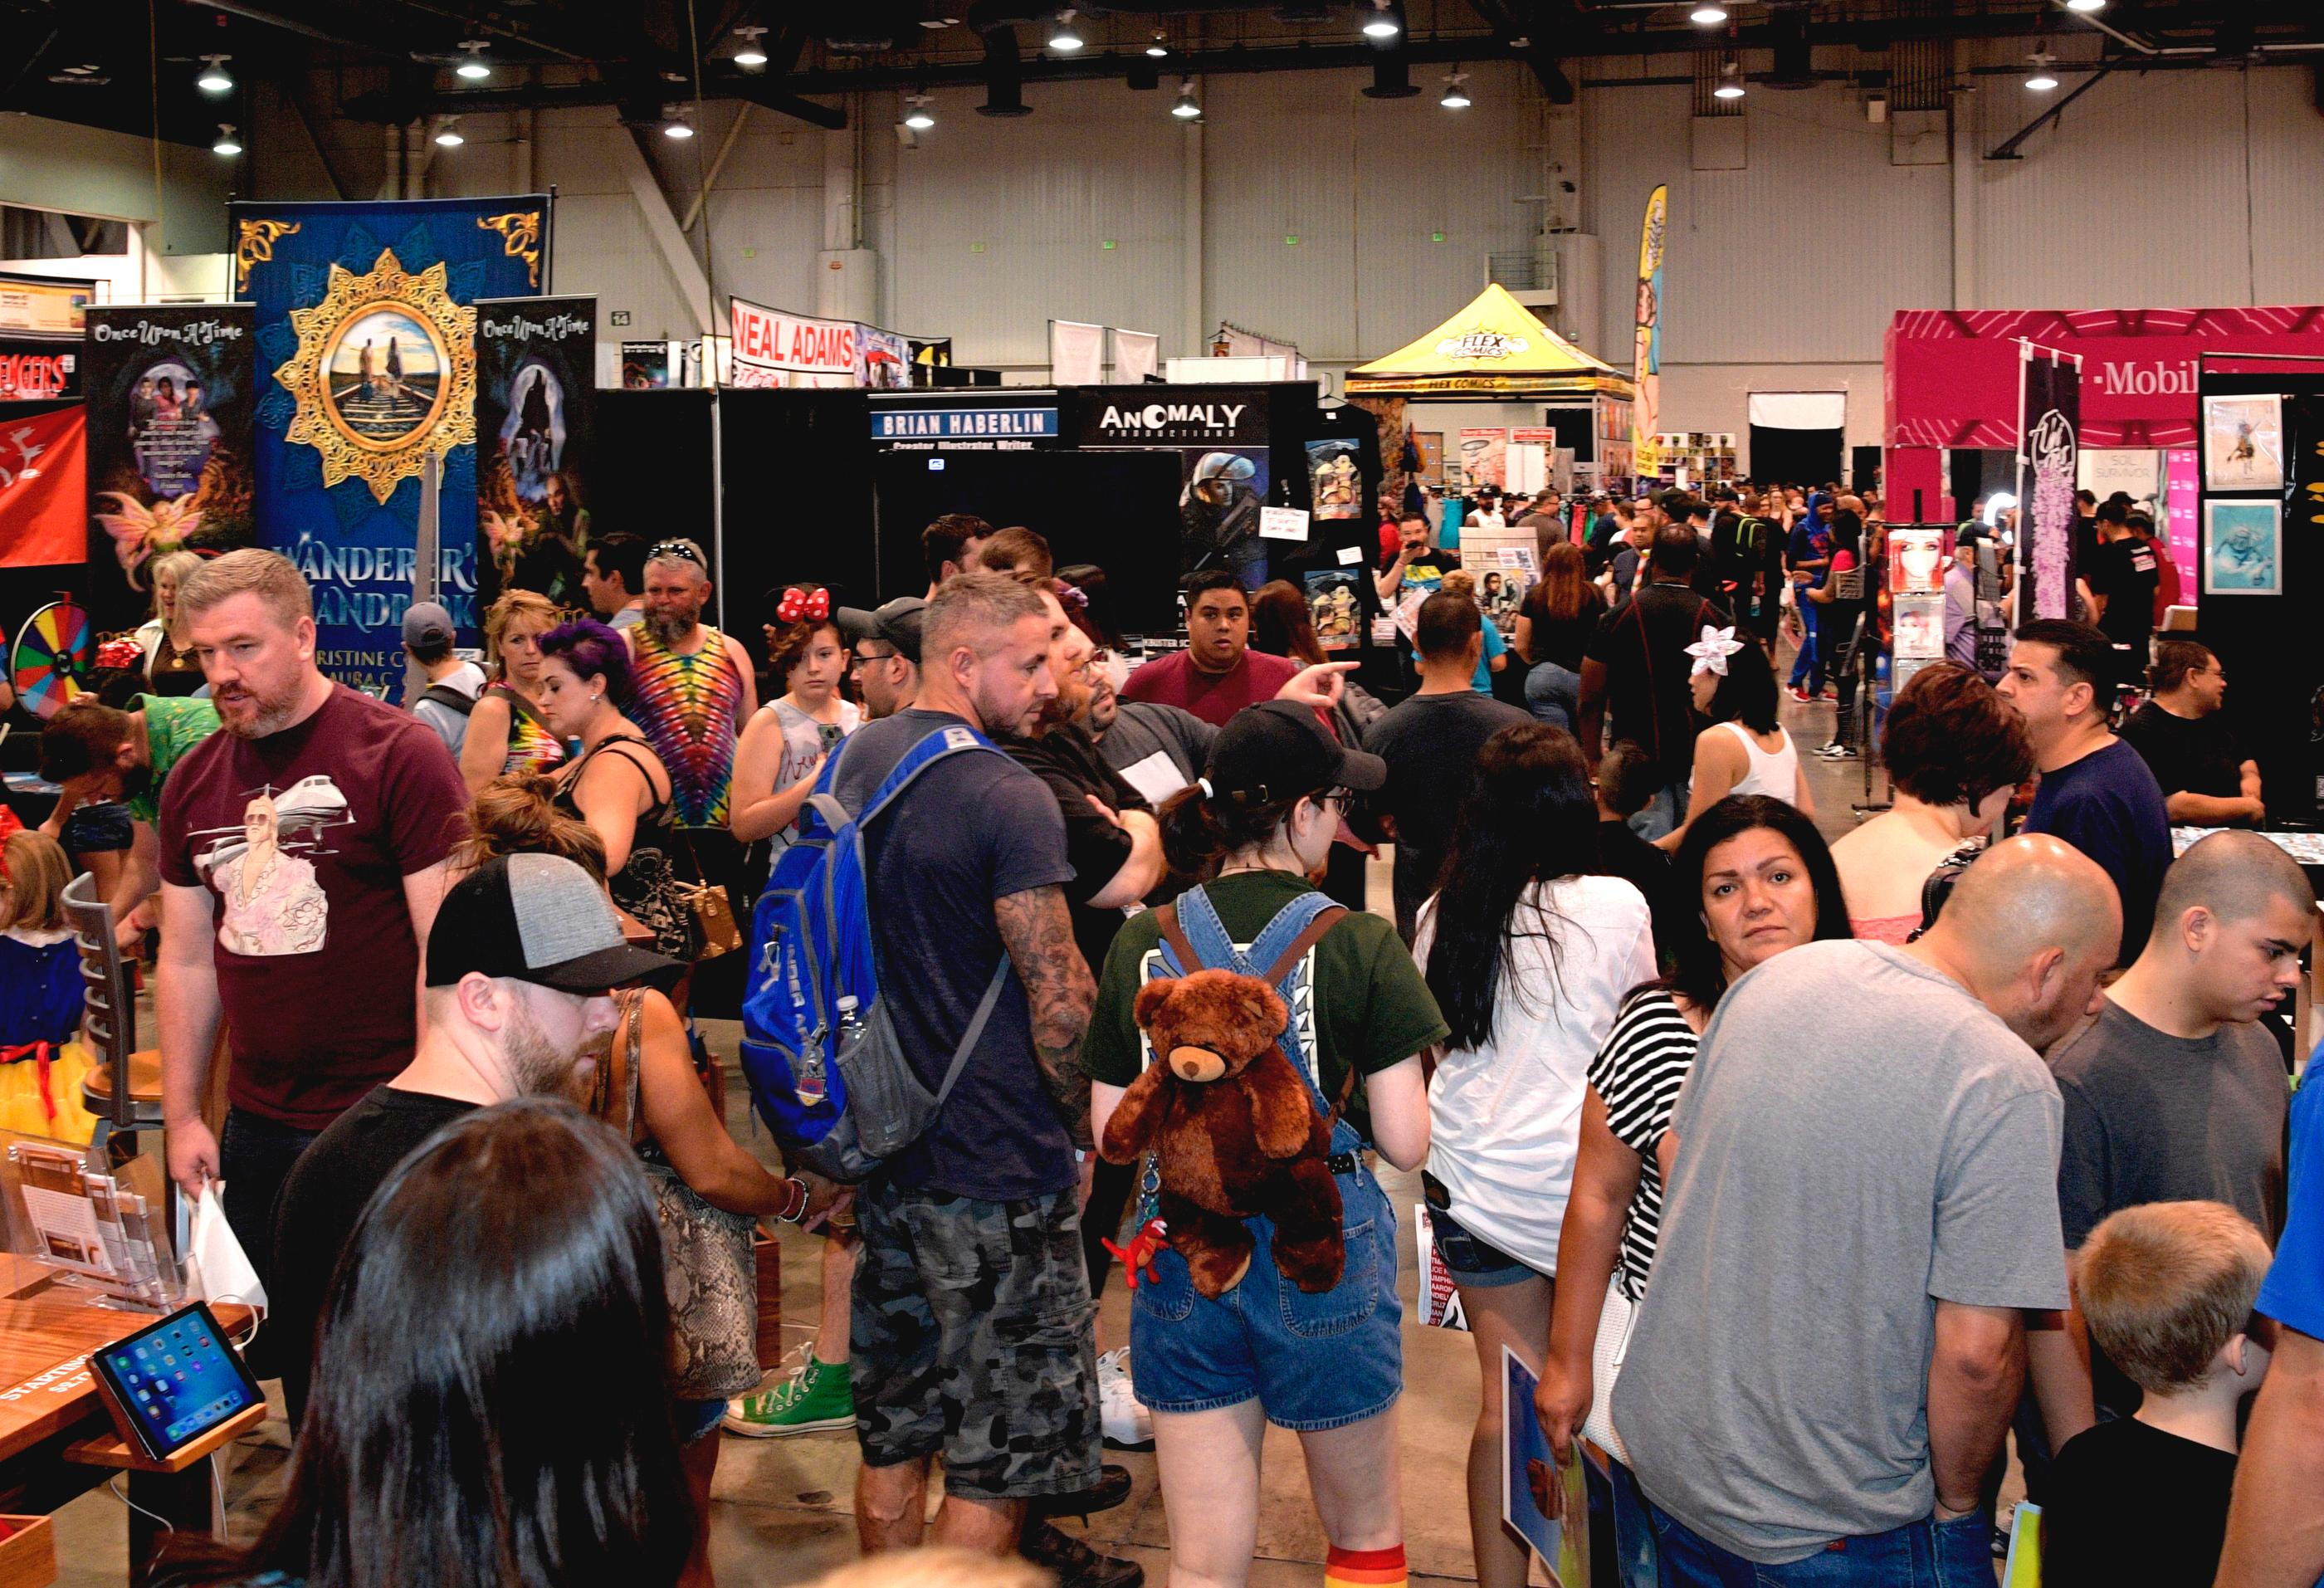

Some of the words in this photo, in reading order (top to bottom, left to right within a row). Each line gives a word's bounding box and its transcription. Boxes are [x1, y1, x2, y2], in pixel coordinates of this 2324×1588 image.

[483, 320, 513, 338] Once
[512, 315, 544, 341] Upon
[556, 313, 589, 339] Time
[613, 315, 628, 325] 14
[94, 324, 139, 342] Once
[137, 320, 182, 345] Upon
[182, 322, 201, 345] A
[199, 319, 243, 344] Time
[732, 306, 784, 361] NEAL
[791, 325, 853, 367] ADAMS
[1462, 335, 1504, 347] FLEX
[1454, 346, 1507, 356] COMICS
[1428, 380, 1451, 389] FLEX
[1454, 379, 1495, 388] COMICS
[883, 415, 940, 435] BRIAN
[949, 413, 1044, 434] HABERLIN
[0, 1354, 91, 1401] STARTING
